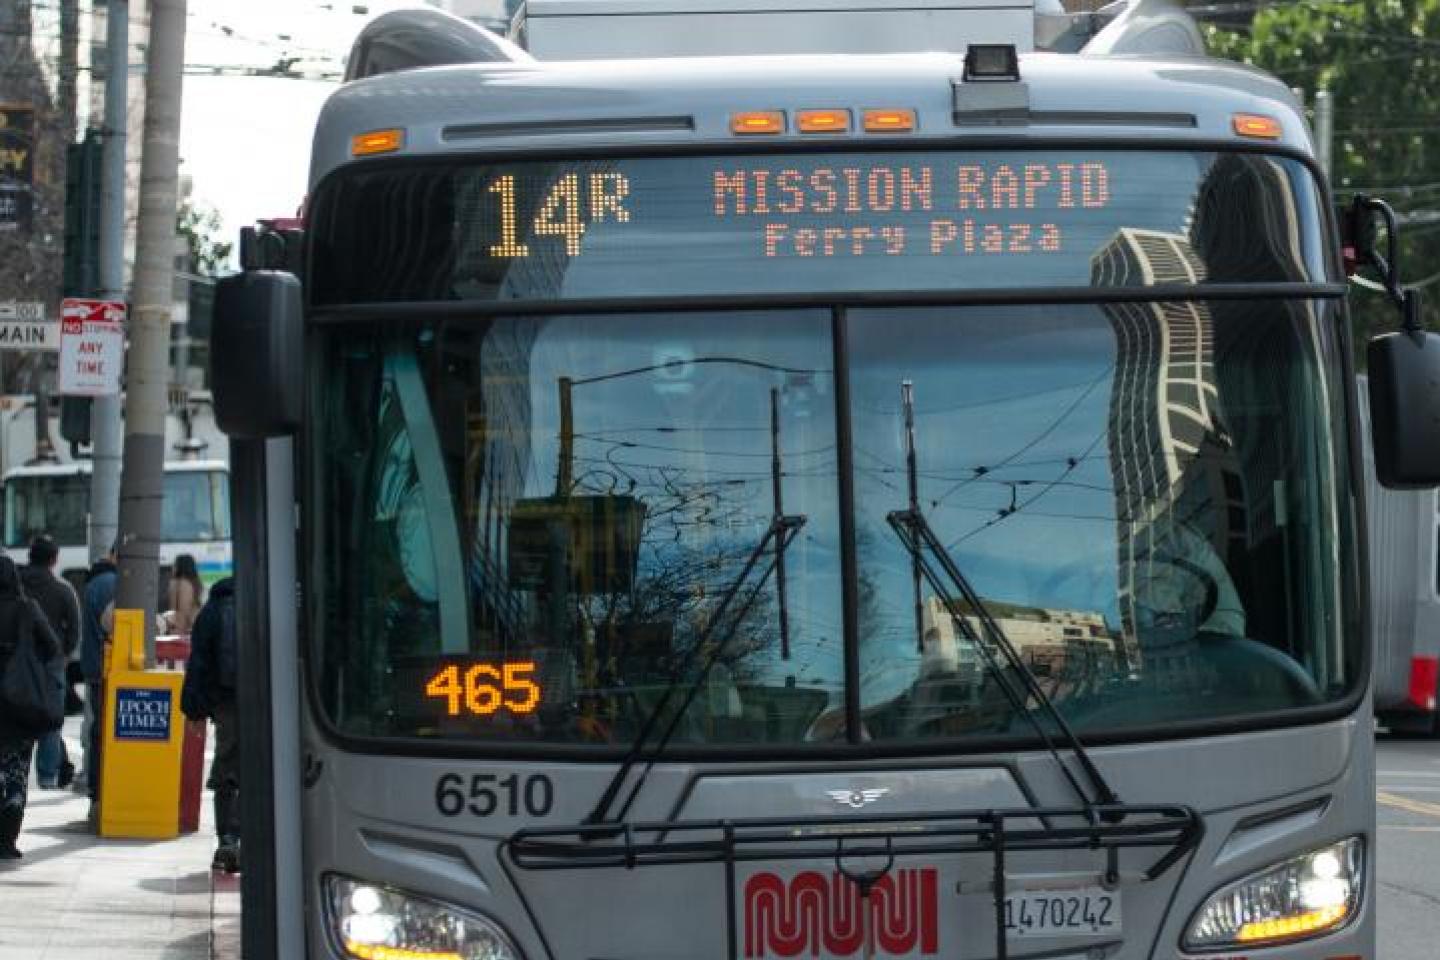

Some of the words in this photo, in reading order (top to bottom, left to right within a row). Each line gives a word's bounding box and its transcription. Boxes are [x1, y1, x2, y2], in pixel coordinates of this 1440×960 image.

[713, 166, 932, 216] MISSION
[957, 163, 1110, 209] RAPID
[764, 222, 905, 257] Ferry
[929, 219, 1063, 254] Plaza
[78, 342, 103, 353] ANY
[77, 361, 104, 375] TIME
[425, 662, 541, 717] 465
[119, 699, 169, 713] EPOCH
[119, 714, 167, 728] TIMES
[435, 772, 554, 817] 6510
[1003, 896, 1113, 928] 1470242
